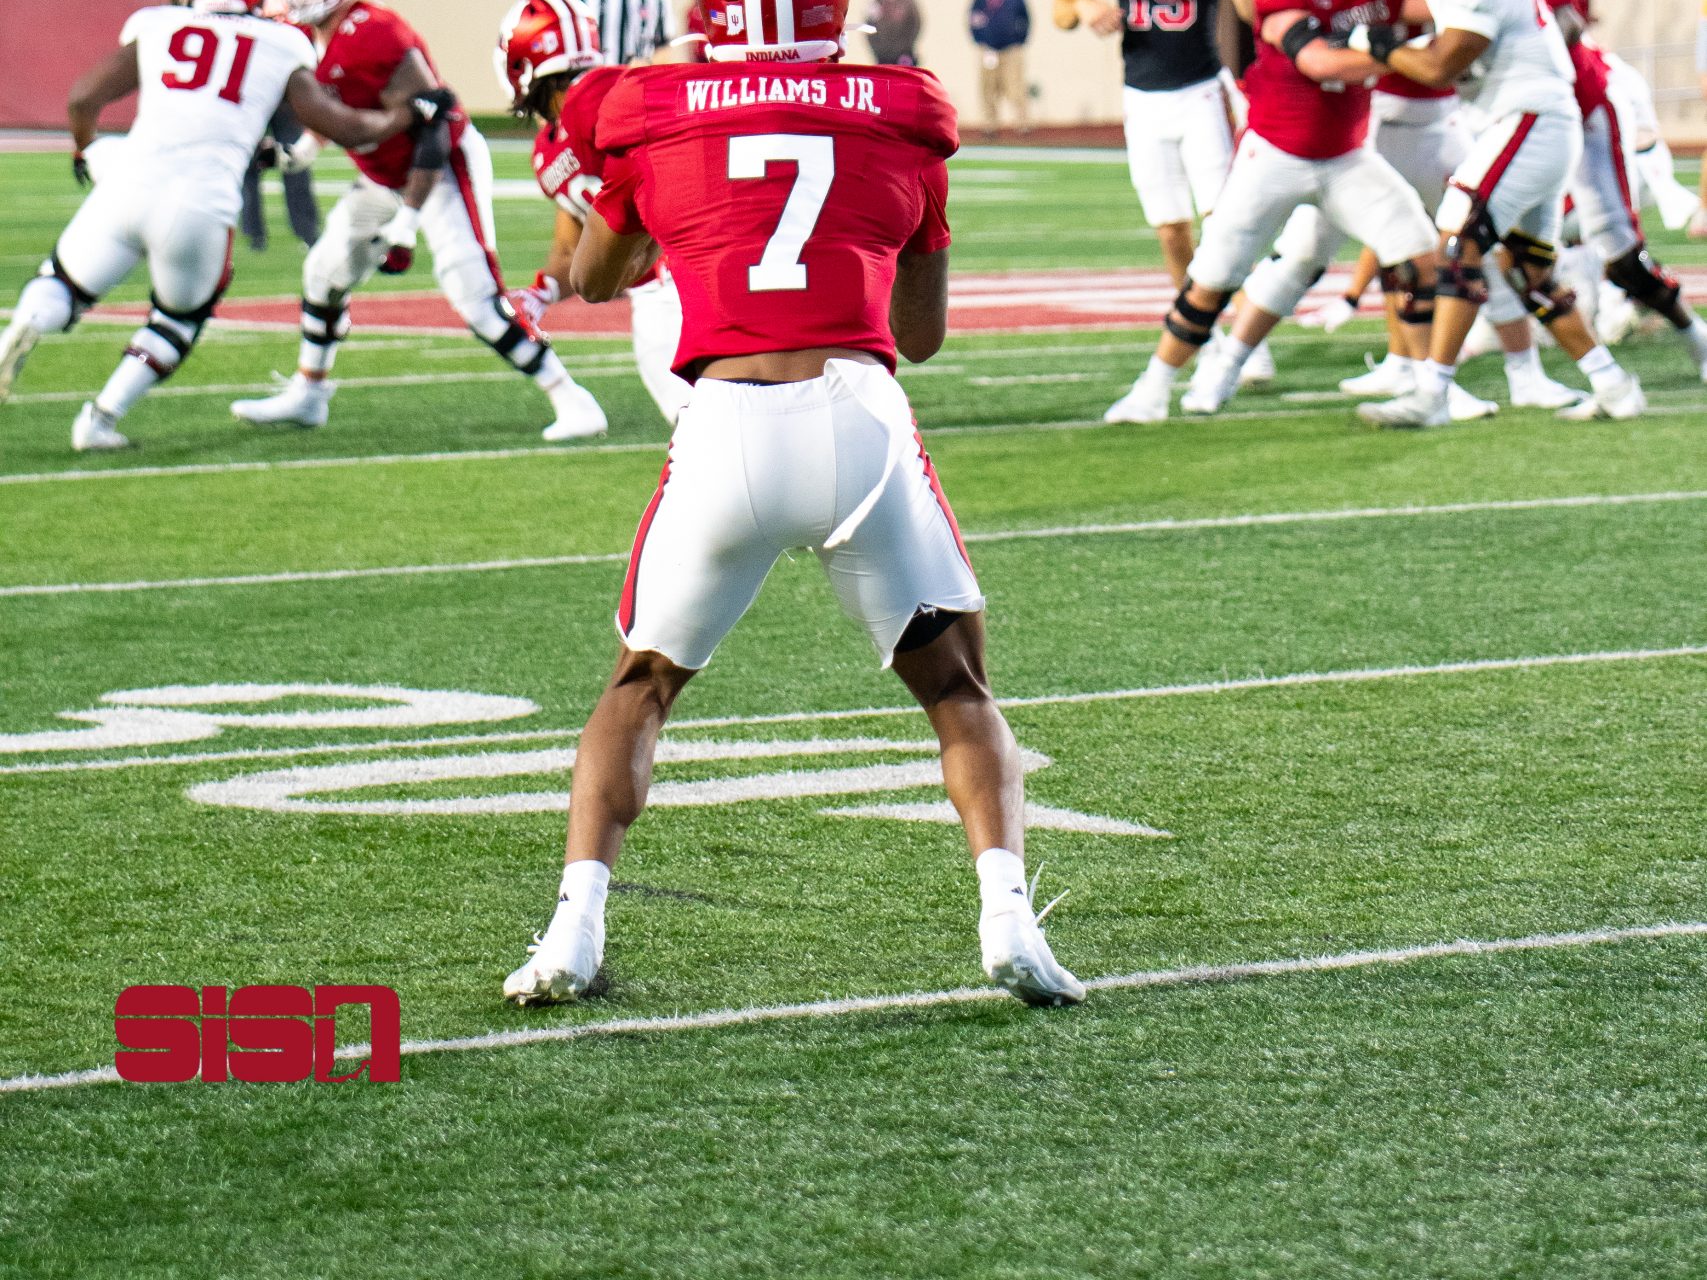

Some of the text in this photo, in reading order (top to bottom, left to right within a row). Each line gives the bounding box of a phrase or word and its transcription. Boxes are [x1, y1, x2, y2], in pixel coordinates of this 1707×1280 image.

[161, 26, 257, 104] 91
[745, 48, 801, 62] INDIANA
[686, 76, 881, 114] WILLIAMS JR.
[727, 133, 835, 293] 7
